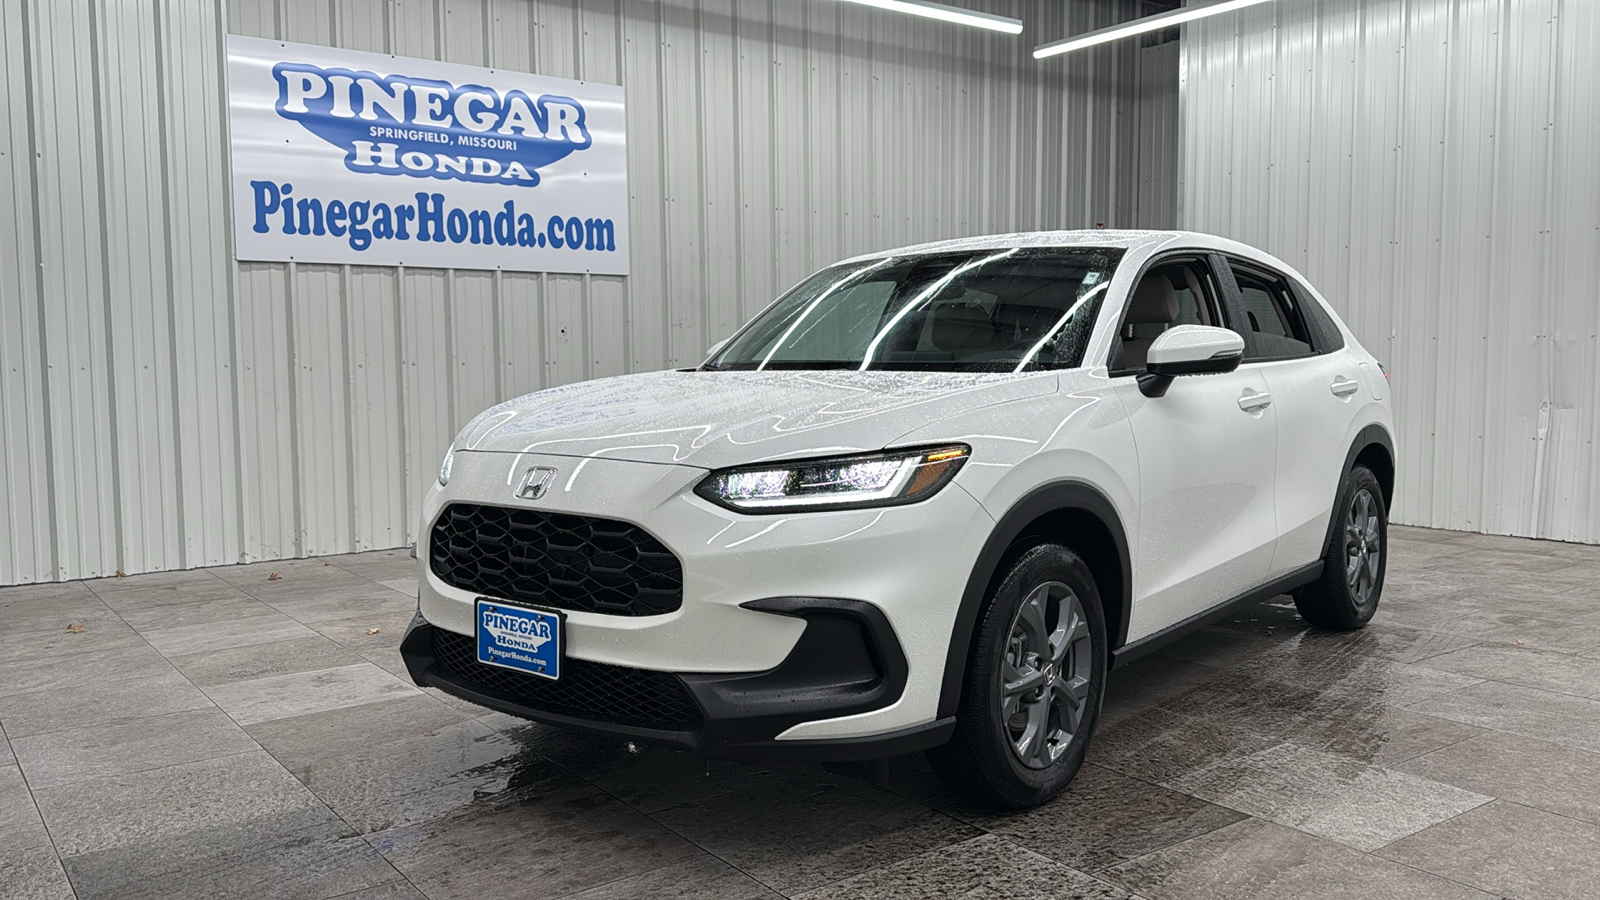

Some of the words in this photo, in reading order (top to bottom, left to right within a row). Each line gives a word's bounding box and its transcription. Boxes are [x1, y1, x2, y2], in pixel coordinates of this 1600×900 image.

[280, 70, 586, 144] PINEGAR
[369, 126, 454, 147] SPRINGFIELD,
[457, 135, 518, 151] MISSOURI
[351, 140, 535, 180] HONDA
[250, 180, 616, 251] PinegarHonda.com
[484, 613, 549, 638] PINEGAR
[497, 635, 536, 650] HONDA
[488, 647, 546, 666] PinegarHonda.com
